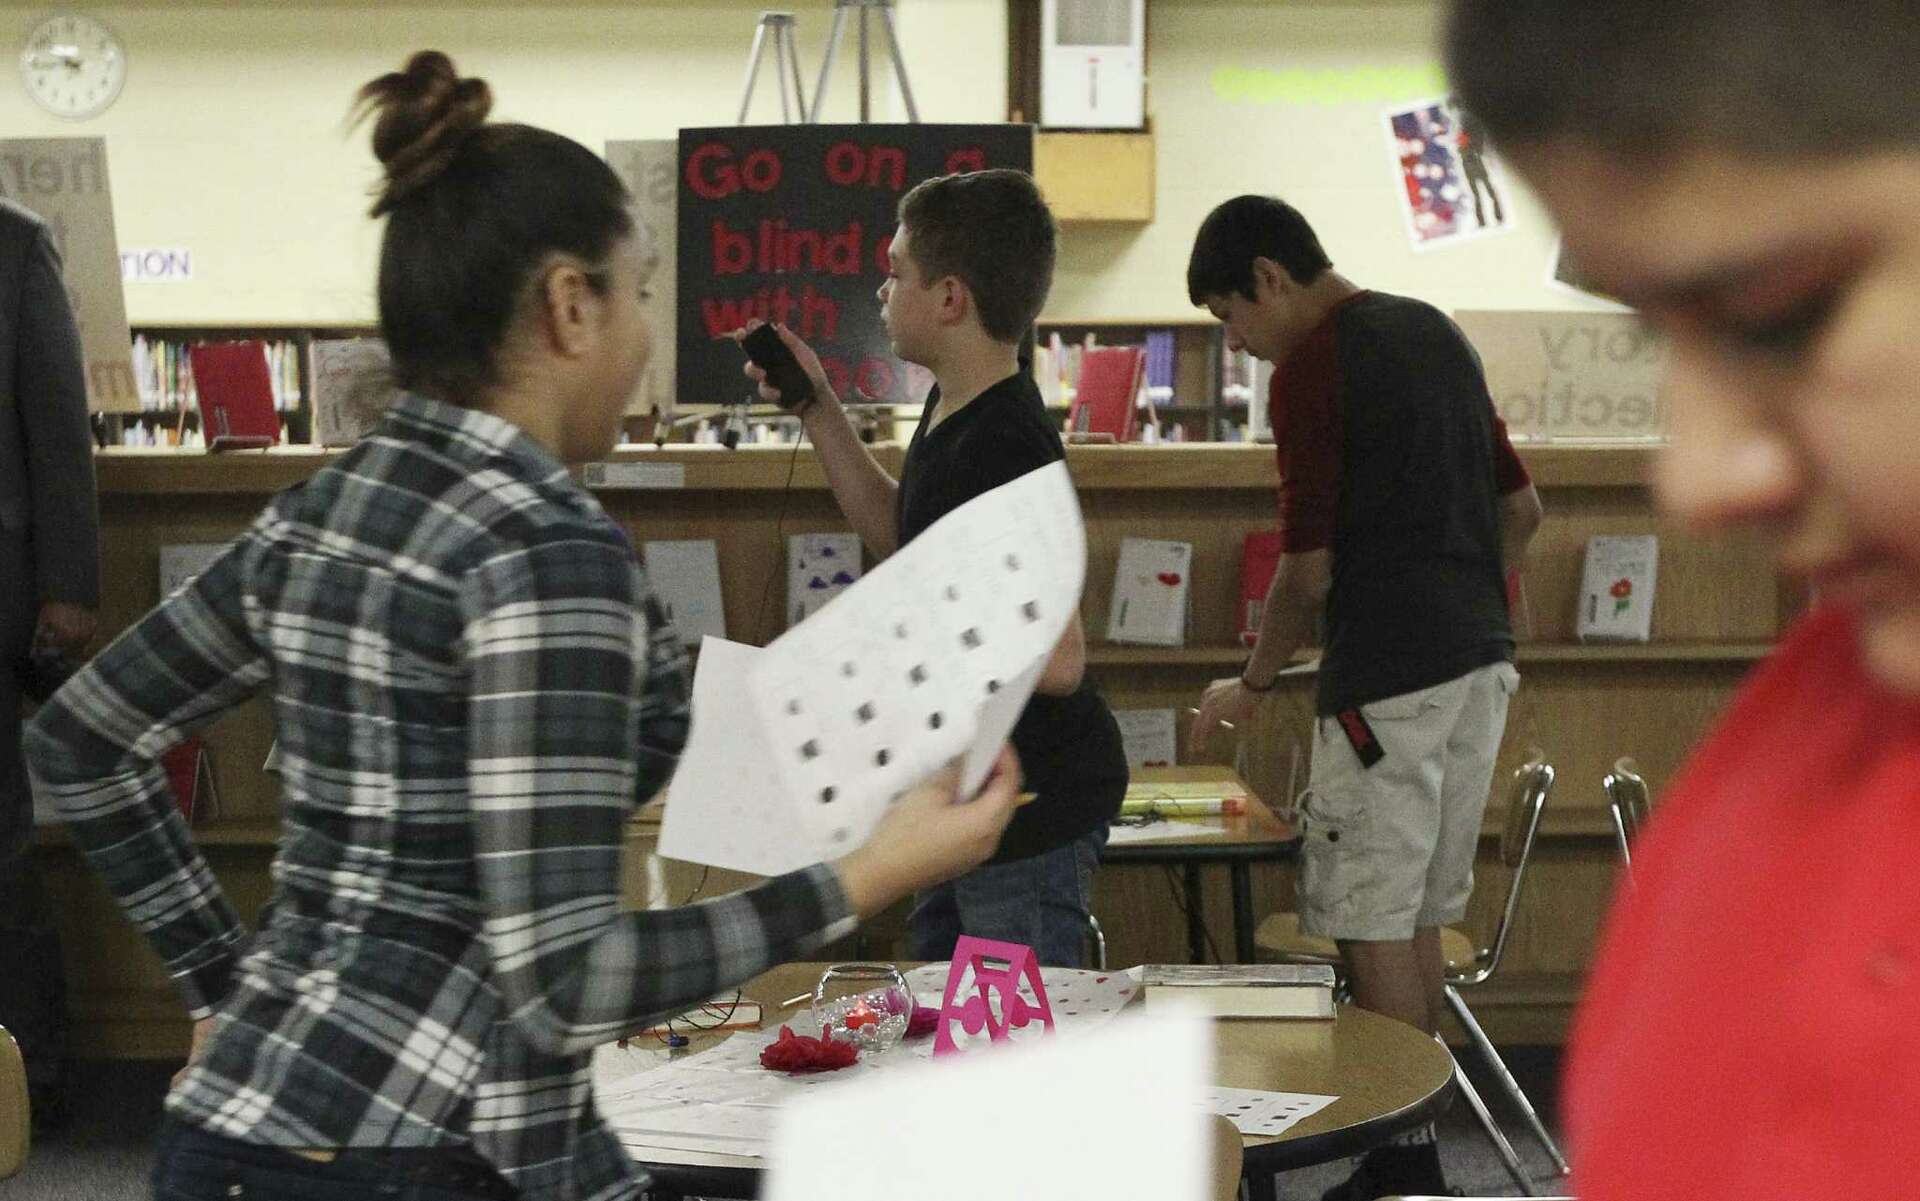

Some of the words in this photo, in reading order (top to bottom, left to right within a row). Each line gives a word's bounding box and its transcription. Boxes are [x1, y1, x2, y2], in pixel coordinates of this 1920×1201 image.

[684, 142, 783, 199] Go
[824, 141, 909, 190] on
[712, 219, 865, 275] blind
[703, 284, 839, 341] with
